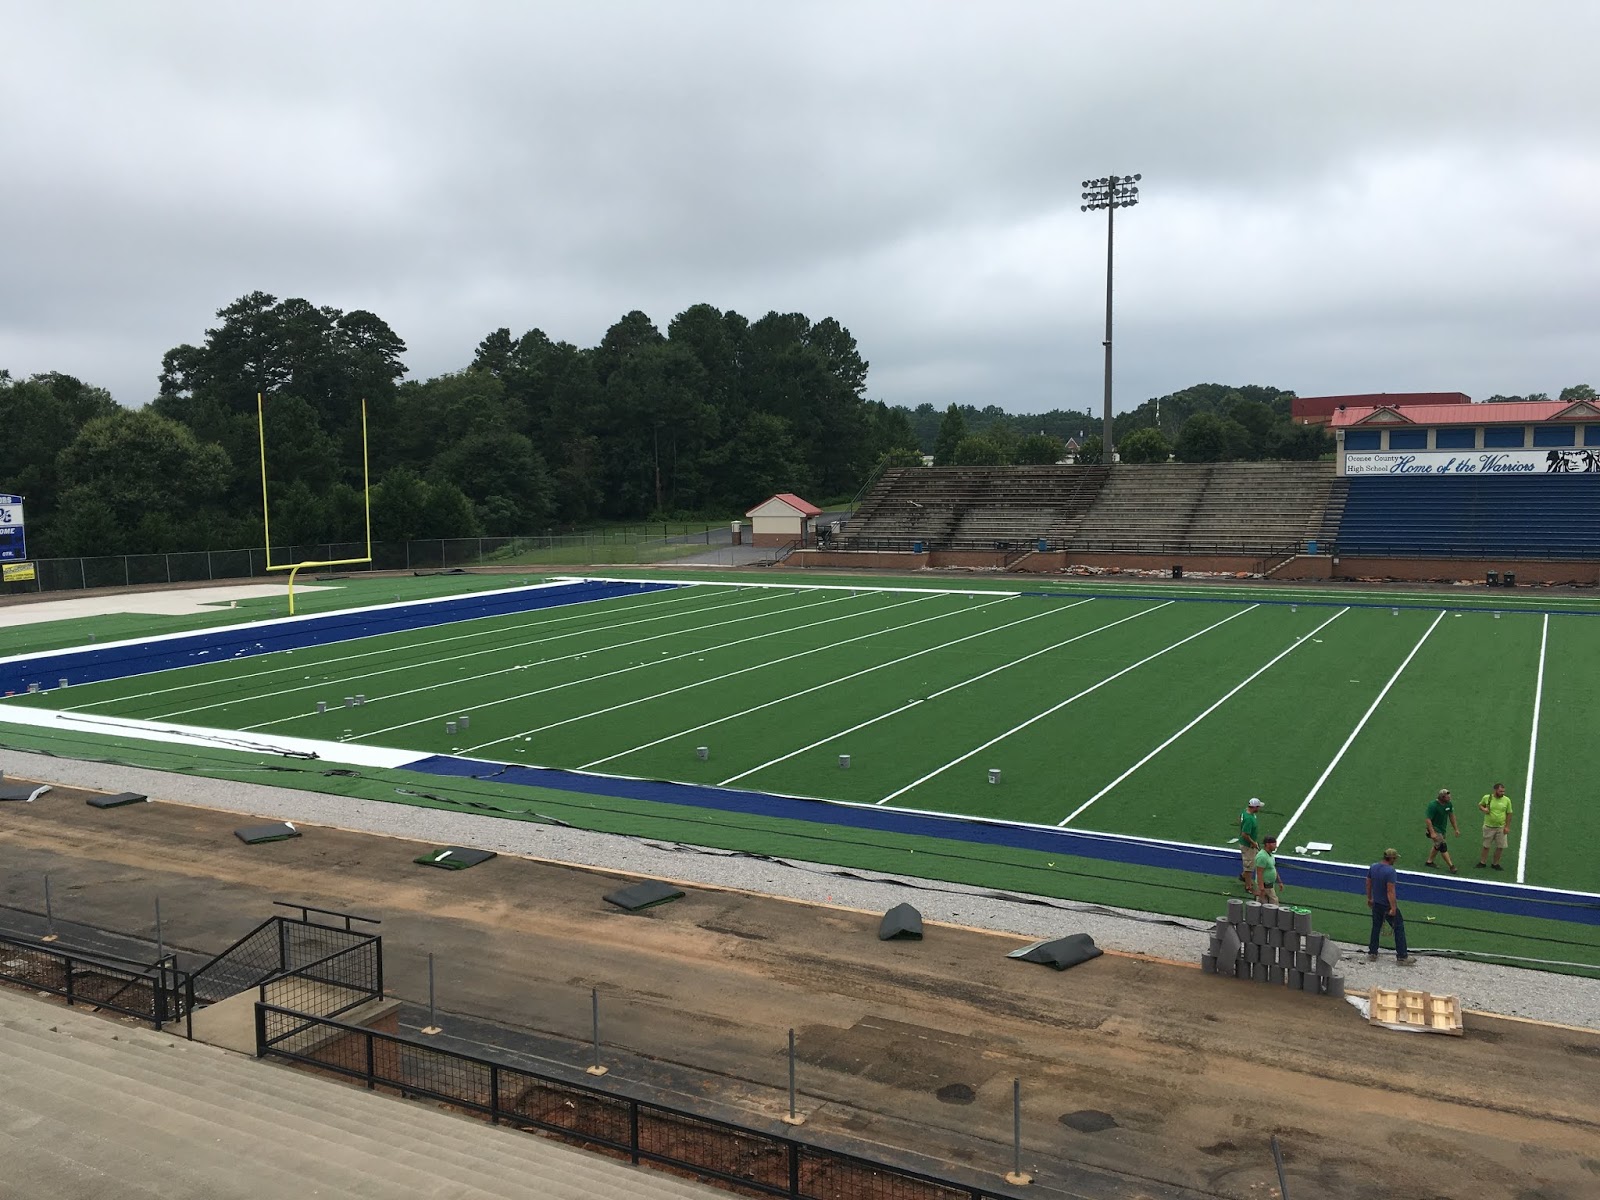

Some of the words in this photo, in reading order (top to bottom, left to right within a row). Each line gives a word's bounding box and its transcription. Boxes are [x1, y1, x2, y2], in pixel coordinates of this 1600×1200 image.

[1374, 455, 1399, 463] County
[1390, 455, 1433, 474] Home
[1436, 457, 1457, 474] of
[1455, 458, 1477, 473] the
[1479, 454, 1536, 473] Warriors
[1347, 465, 1364, 473] High
